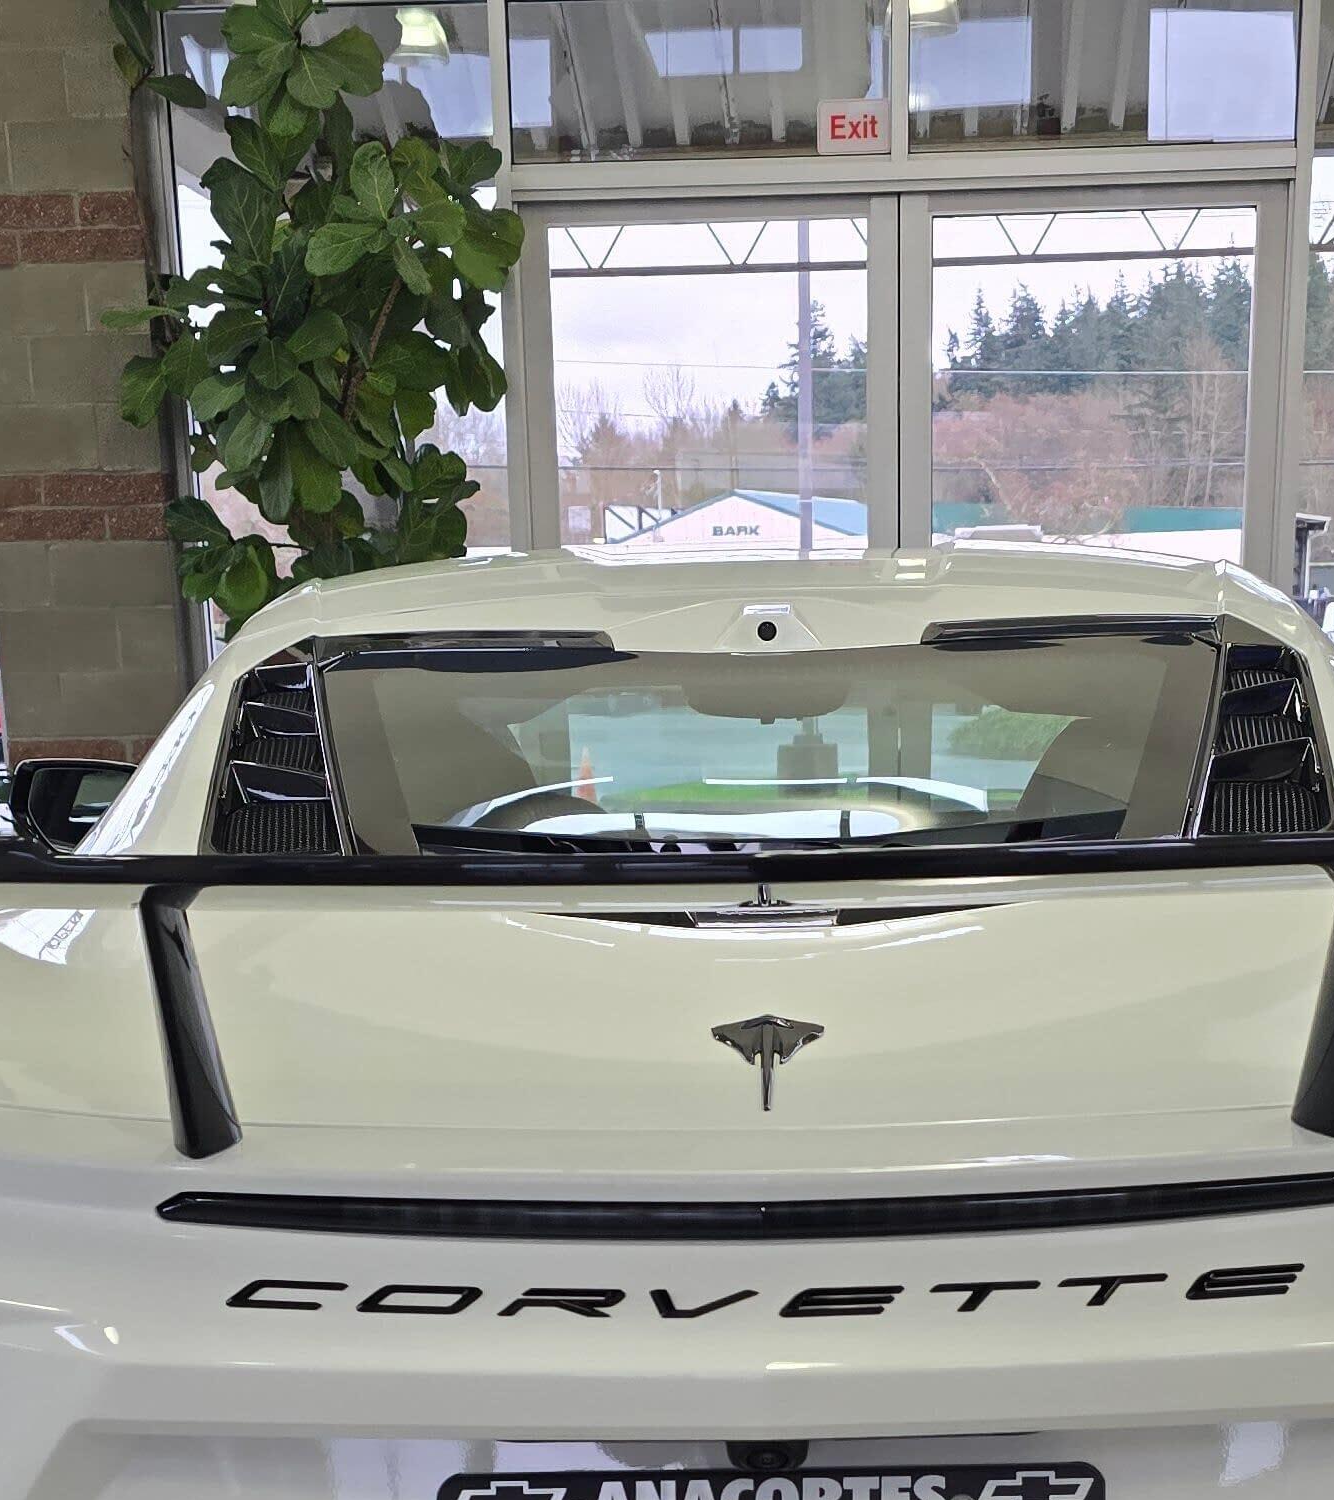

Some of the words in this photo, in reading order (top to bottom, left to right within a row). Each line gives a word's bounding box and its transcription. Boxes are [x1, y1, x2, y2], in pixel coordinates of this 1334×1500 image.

[830, 114, 878, 140] Exit
[712, 525, 760, 537] BARK
[225, 1262, 1305, 1319] CORVETTE
